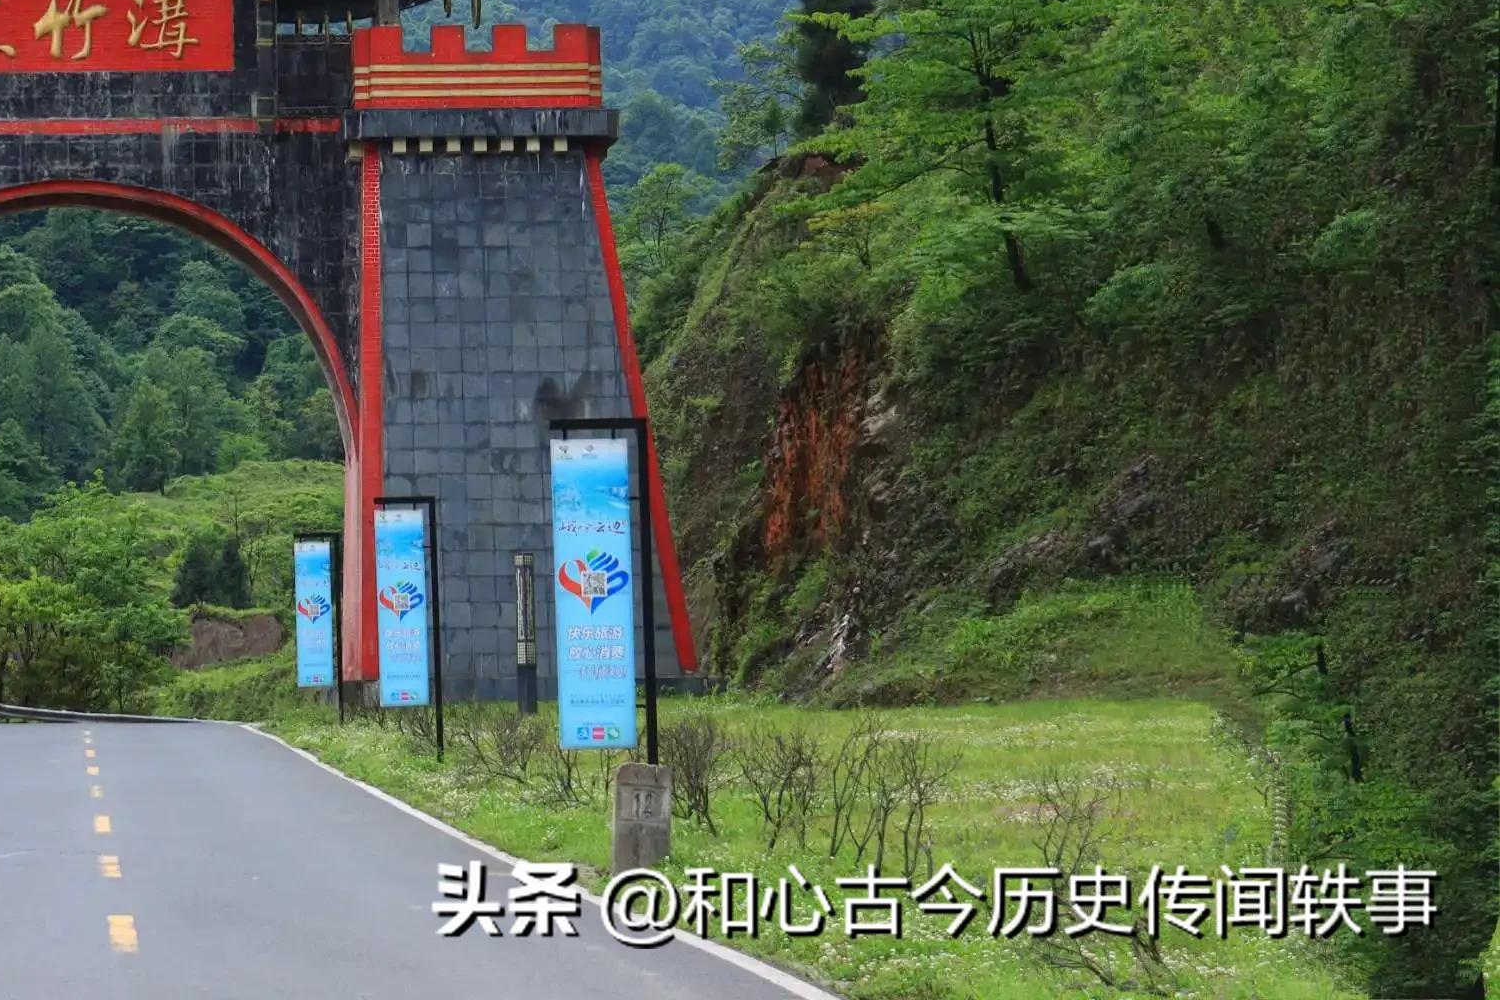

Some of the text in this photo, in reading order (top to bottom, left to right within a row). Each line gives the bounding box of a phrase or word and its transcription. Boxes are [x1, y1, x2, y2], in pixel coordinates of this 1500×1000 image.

[567, 625, 622, 640] 快乐旅游
[568, 645, 624, 660] 放心消费
